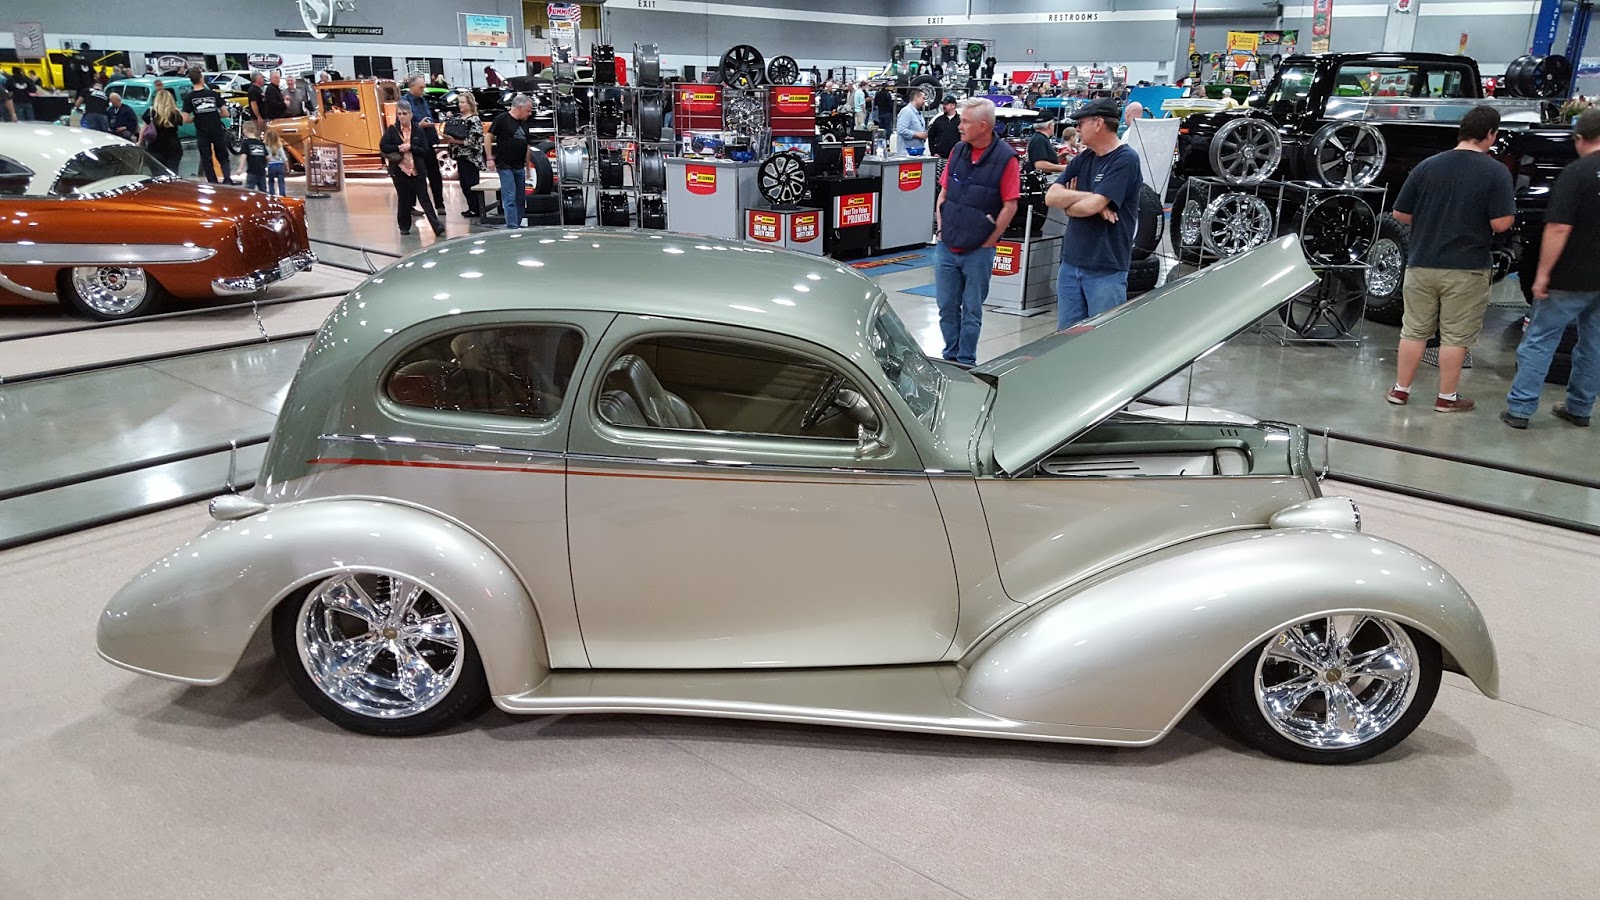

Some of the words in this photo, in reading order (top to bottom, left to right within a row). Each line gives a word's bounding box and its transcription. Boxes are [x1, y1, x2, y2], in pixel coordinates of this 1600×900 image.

[638, 0, 656, 8] EXIT
[549, 4, 572, 15] SUMMIT
[927, 17, 944, 25] EXIT
[1048, 13, 1099, 22] RESTROOMS
[1549, 7, 1560, 39] ATLAS
[843, 208, 852, 216] Best
[847, 213, 871, 224] PROMISE
[998, 263, 1012, 271] CHECK
